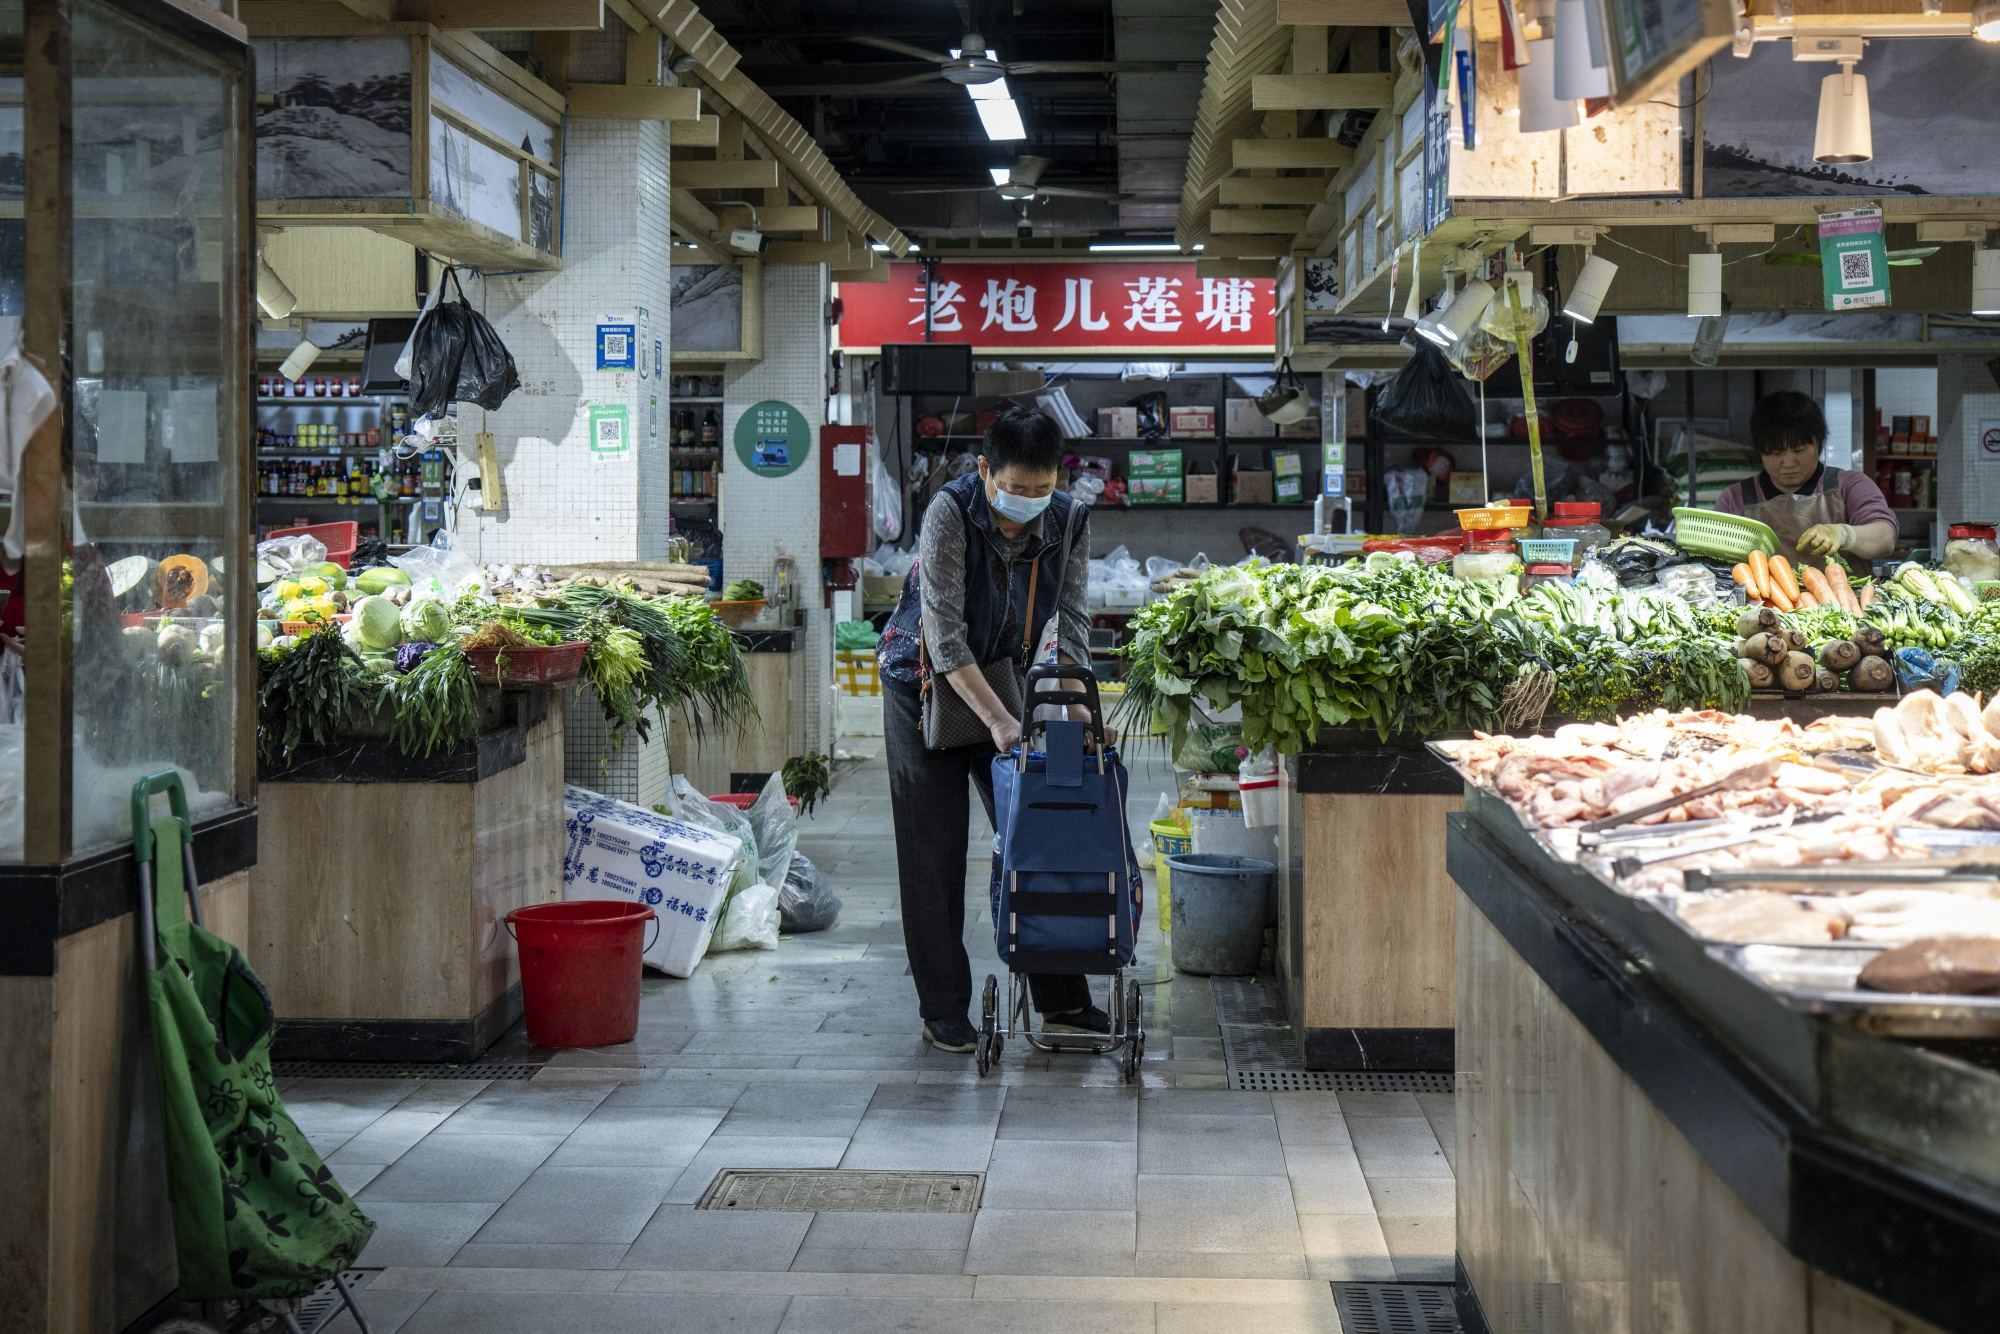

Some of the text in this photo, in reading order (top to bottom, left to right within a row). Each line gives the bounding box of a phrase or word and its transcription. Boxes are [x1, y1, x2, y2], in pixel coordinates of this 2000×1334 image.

[907, 276, 1275, 333] 老炮儿莲塘
[597, 831, 630, 847] 18923753461
[595, 841, 630, 857] 18928451811
[660, 853, 722, 886] 福相容香
[601, 879, 635, 895] 18928451811
[604, 871, 637, 888] 18923753461
[666, 896, 708, 922] 福相容
